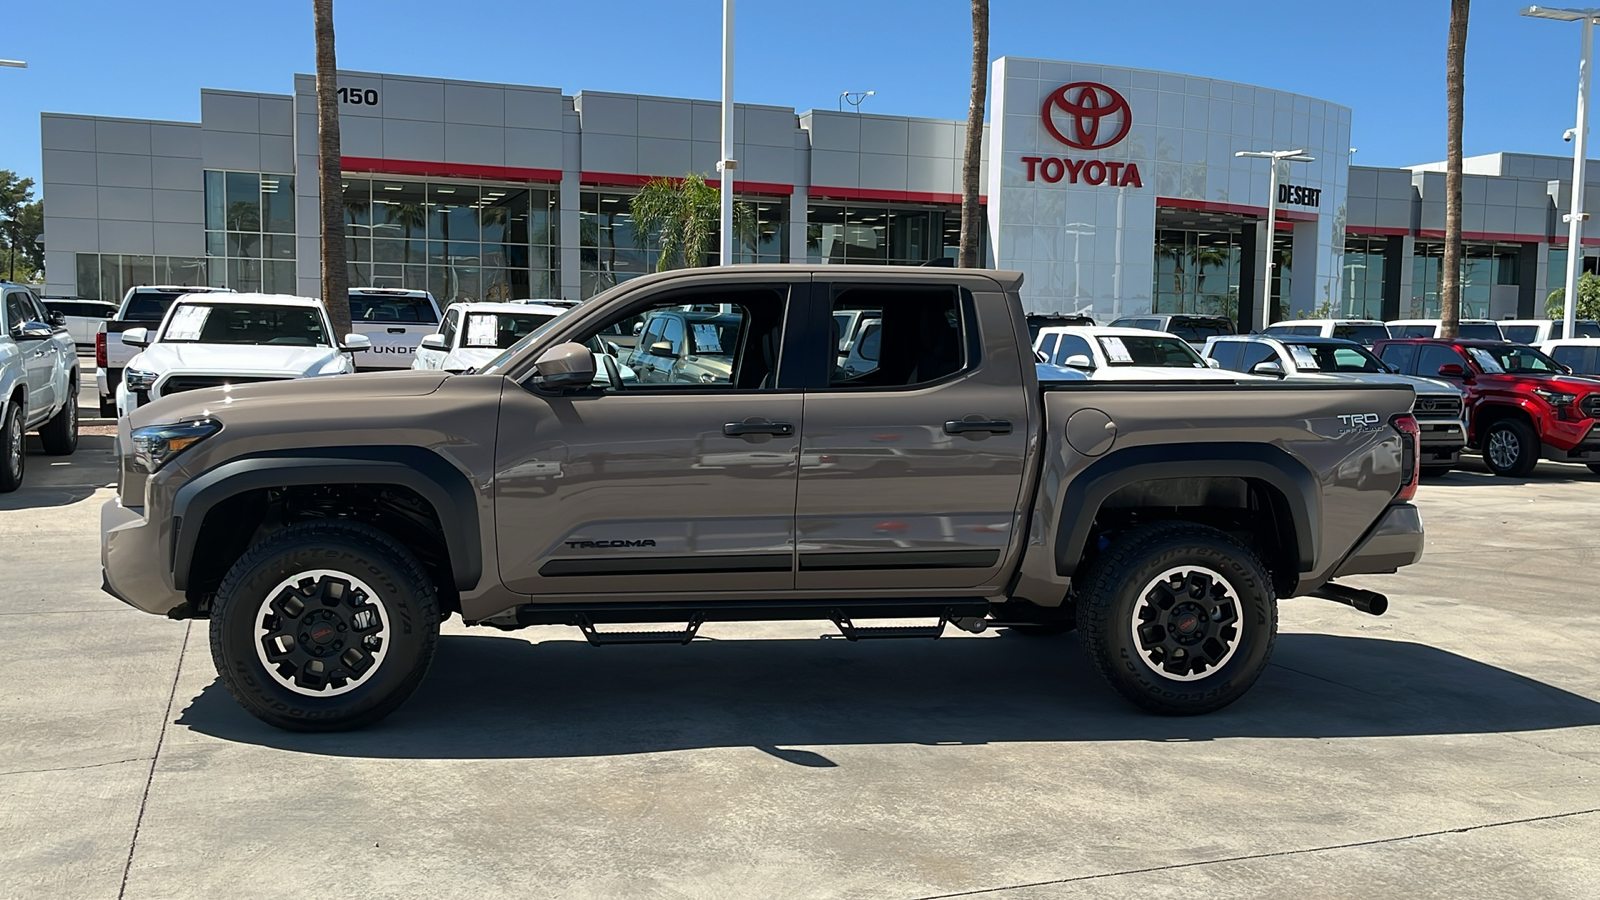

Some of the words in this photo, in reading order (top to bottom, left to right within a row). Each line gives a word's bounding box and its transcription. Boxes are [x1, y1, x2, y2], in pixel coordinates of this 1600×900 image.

[1021, 156, 1142, 188] TOYOTA
[1278, 183, 1322, 208] DESERT
[1337, 413, 1379, 427] TRD
[564, 539, 656, 549] TACOMA
